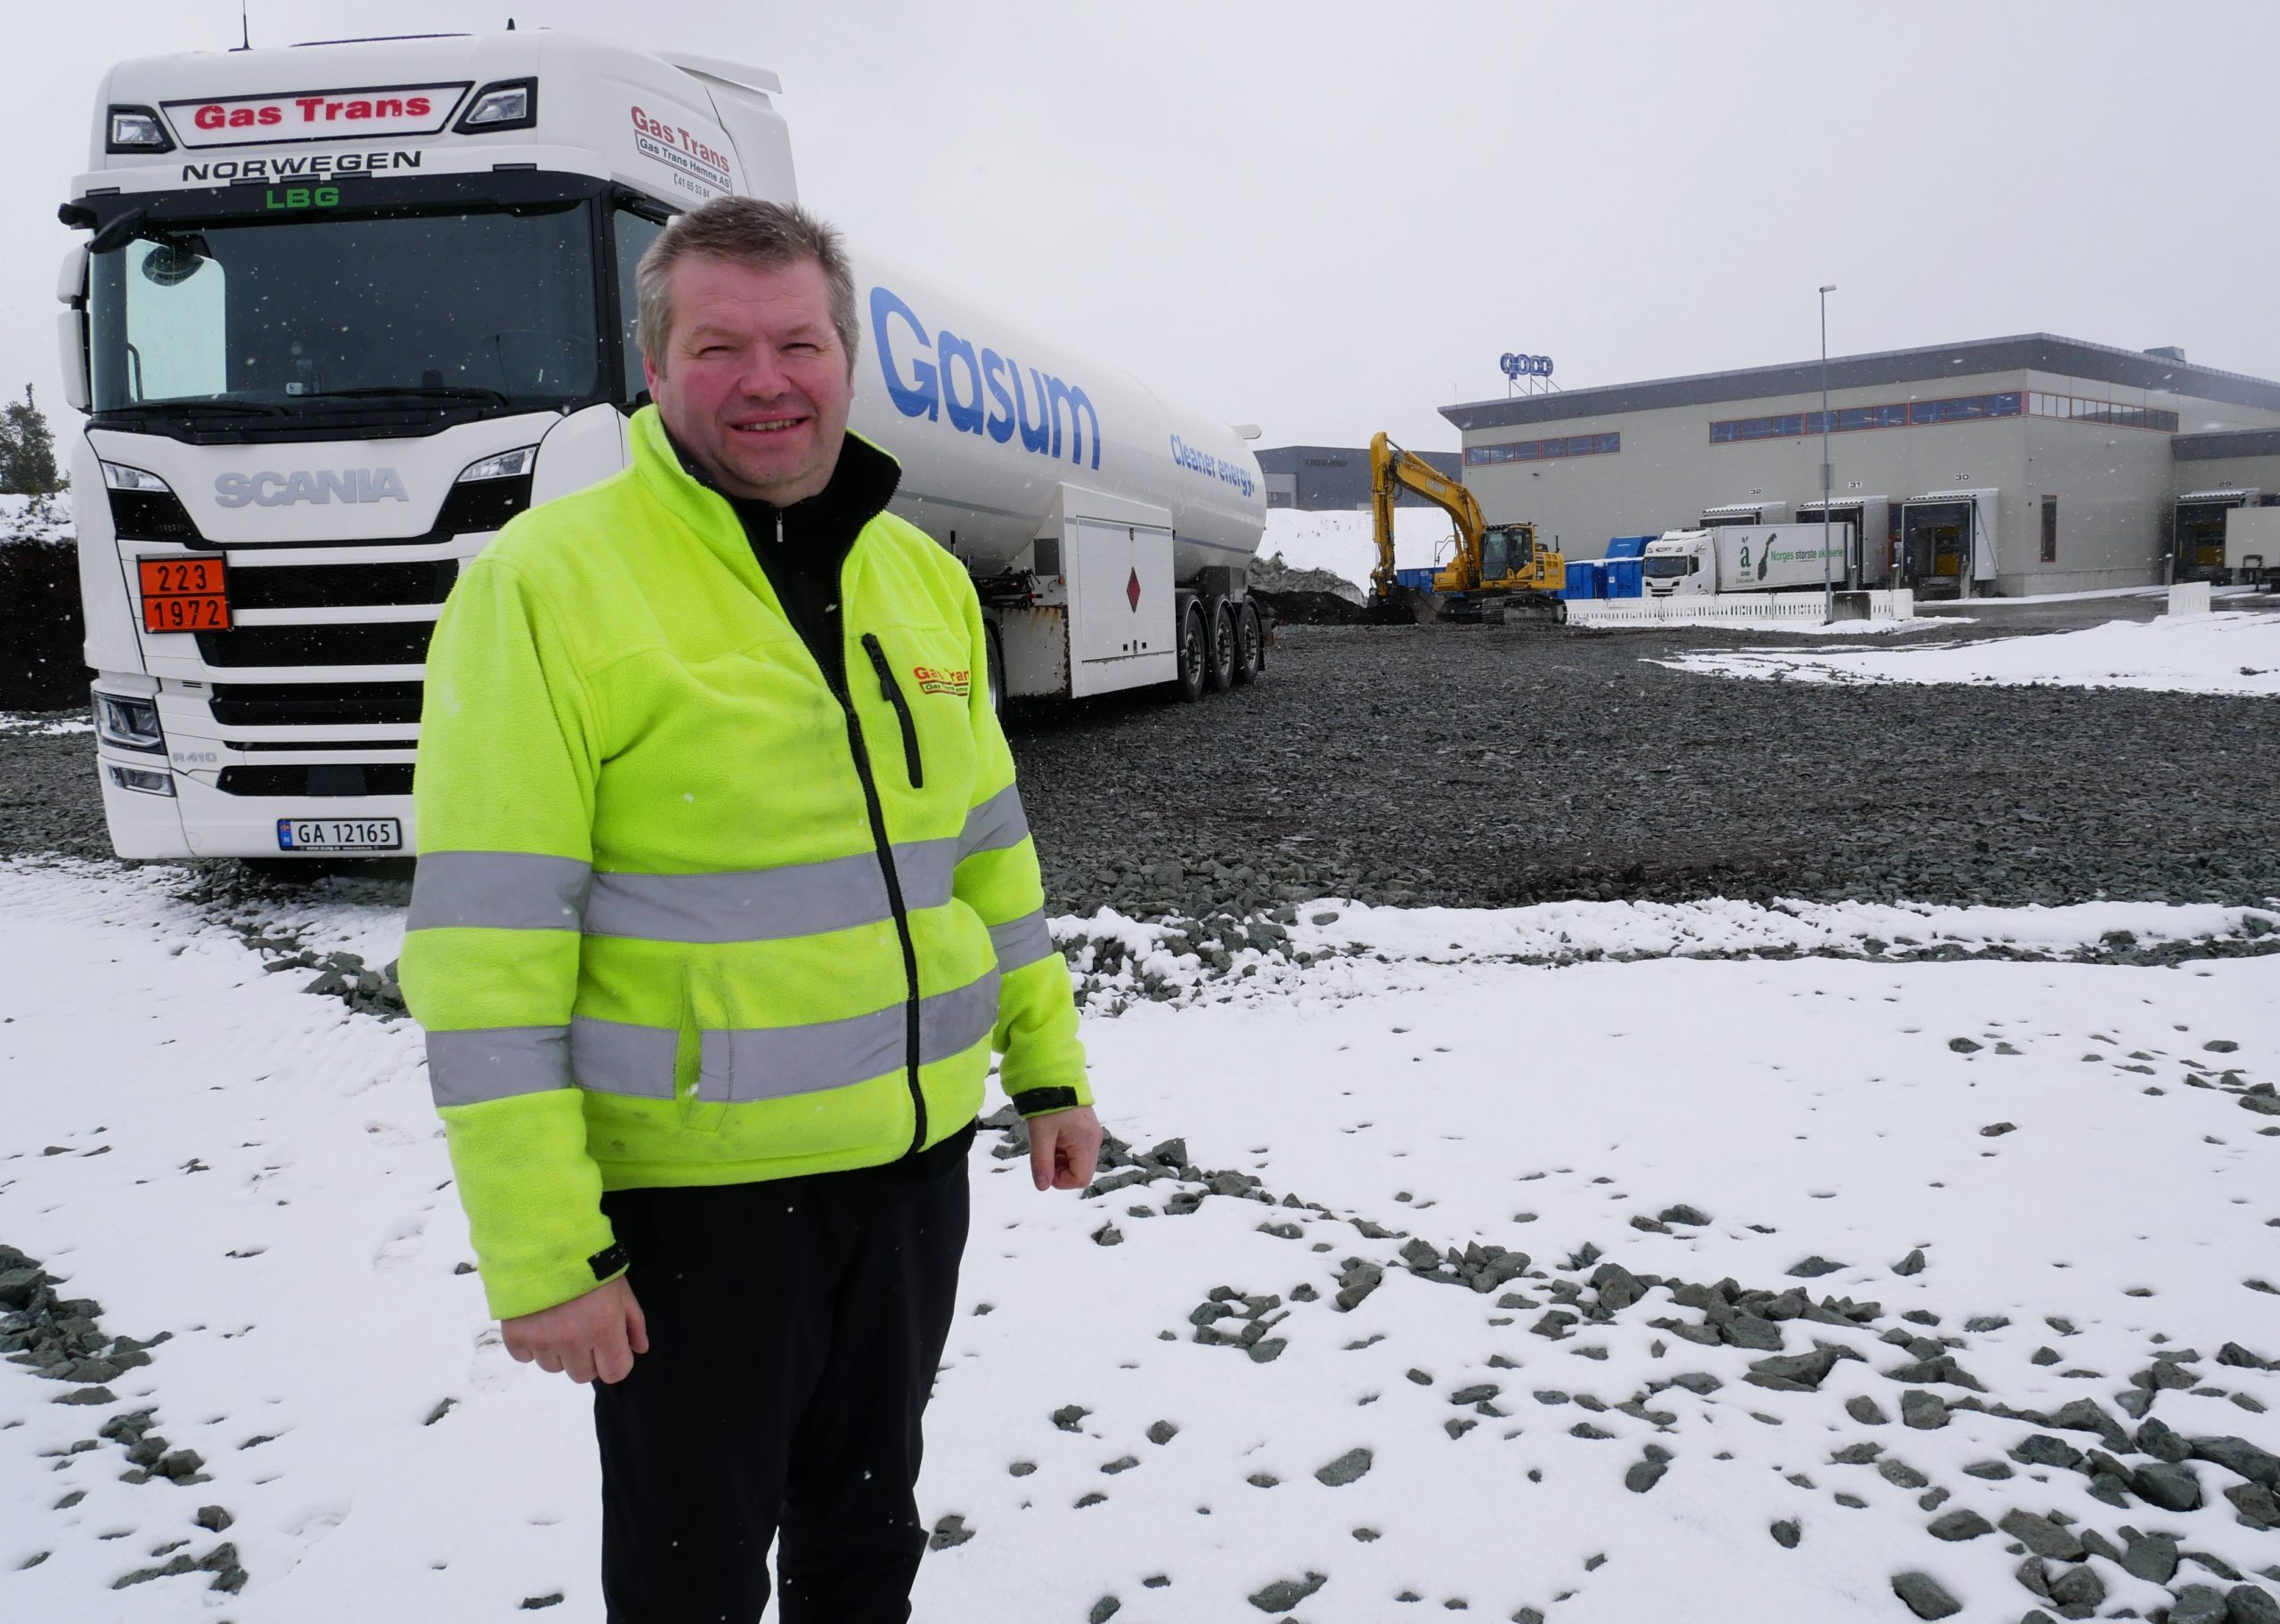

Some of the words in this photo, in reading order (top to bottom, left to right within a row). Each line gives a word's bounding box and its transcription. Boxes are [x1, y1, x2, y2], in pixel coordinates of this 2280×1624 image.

[194, 105, 282, 130] Gas
[296, 96, 431, 122] Trans
[631, 106, 675, 143] Gas
[677, 126, 730, 173] Trans
[183, 150, 422, 182] NORWEGEN
[639, 138, 660, 155] Gas
[662, 147, 688, 167] Trans
[689, 160, 718, 182] Hemne
[719, 176, 730, 188] AS
[678, 177, 685, 188] 41
[267, 187, 339, 209] LBG
[870, 287, 1101, 470] Gasum
[1169, 434, 1217, 479] Cleaner
[1217, 459, 1255, 499] energy.
[1954, 473, 1970, 482] 30
[214, 467, 411, 509] SCANIA
[1749, 487, 1763, 496] 32
[1848, 481, 1862, 489] 31
[1771, 550, 1795, 563] Norges
[1796, 548, 1817, 560] største
[157, 564, 208, 591] 223
[154, 599, 220, 627] 1972
[298, 824, 325, 842] GA
[333, 824, 390, 842] 12165
